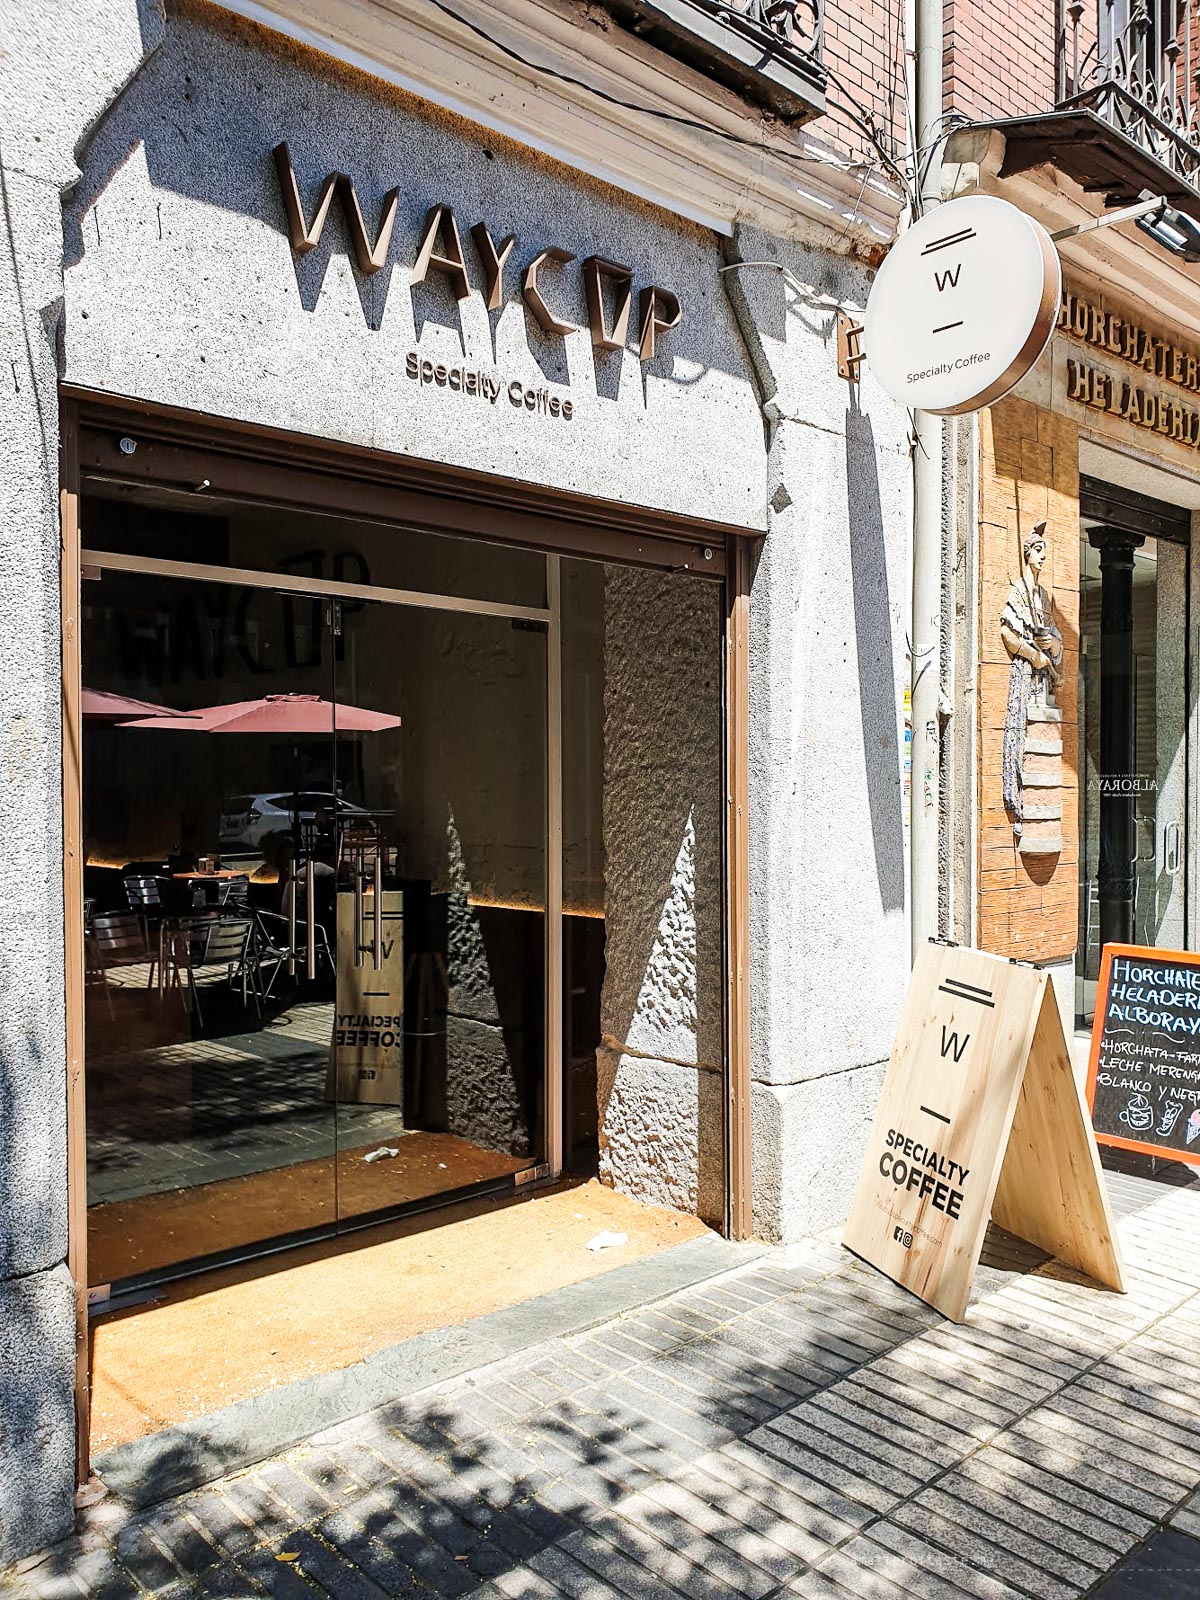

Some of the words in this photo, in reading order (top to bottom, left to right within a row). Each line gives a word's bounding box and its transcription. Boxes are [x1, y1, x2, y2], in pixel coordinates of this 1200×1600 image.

[273, 141, 683, 361] WAYCUP
[934, 263, 962, 292] W
[1056, 291, 1200, 393] HORCHATER
[406, 352, 500, 402] Specialty
[508, 379, 573, 417] Coffee
[907, 363, 954, 384] Specialty
[954, 352, 991, 369] Coffee
[1071, 361, 1200, 446] HELADERI
[1108, 1003, 1200, 1035] ALBORAY
[939, 1024, 971, 1063] W
[1101, 1056, 1144, 1072] LECHE
[1099, 1073, 1151, 1092] BLANCO
[885, 1128, 970, 1186] SPECIALTY
[879, 1152, 964, 1220] COFFEE
